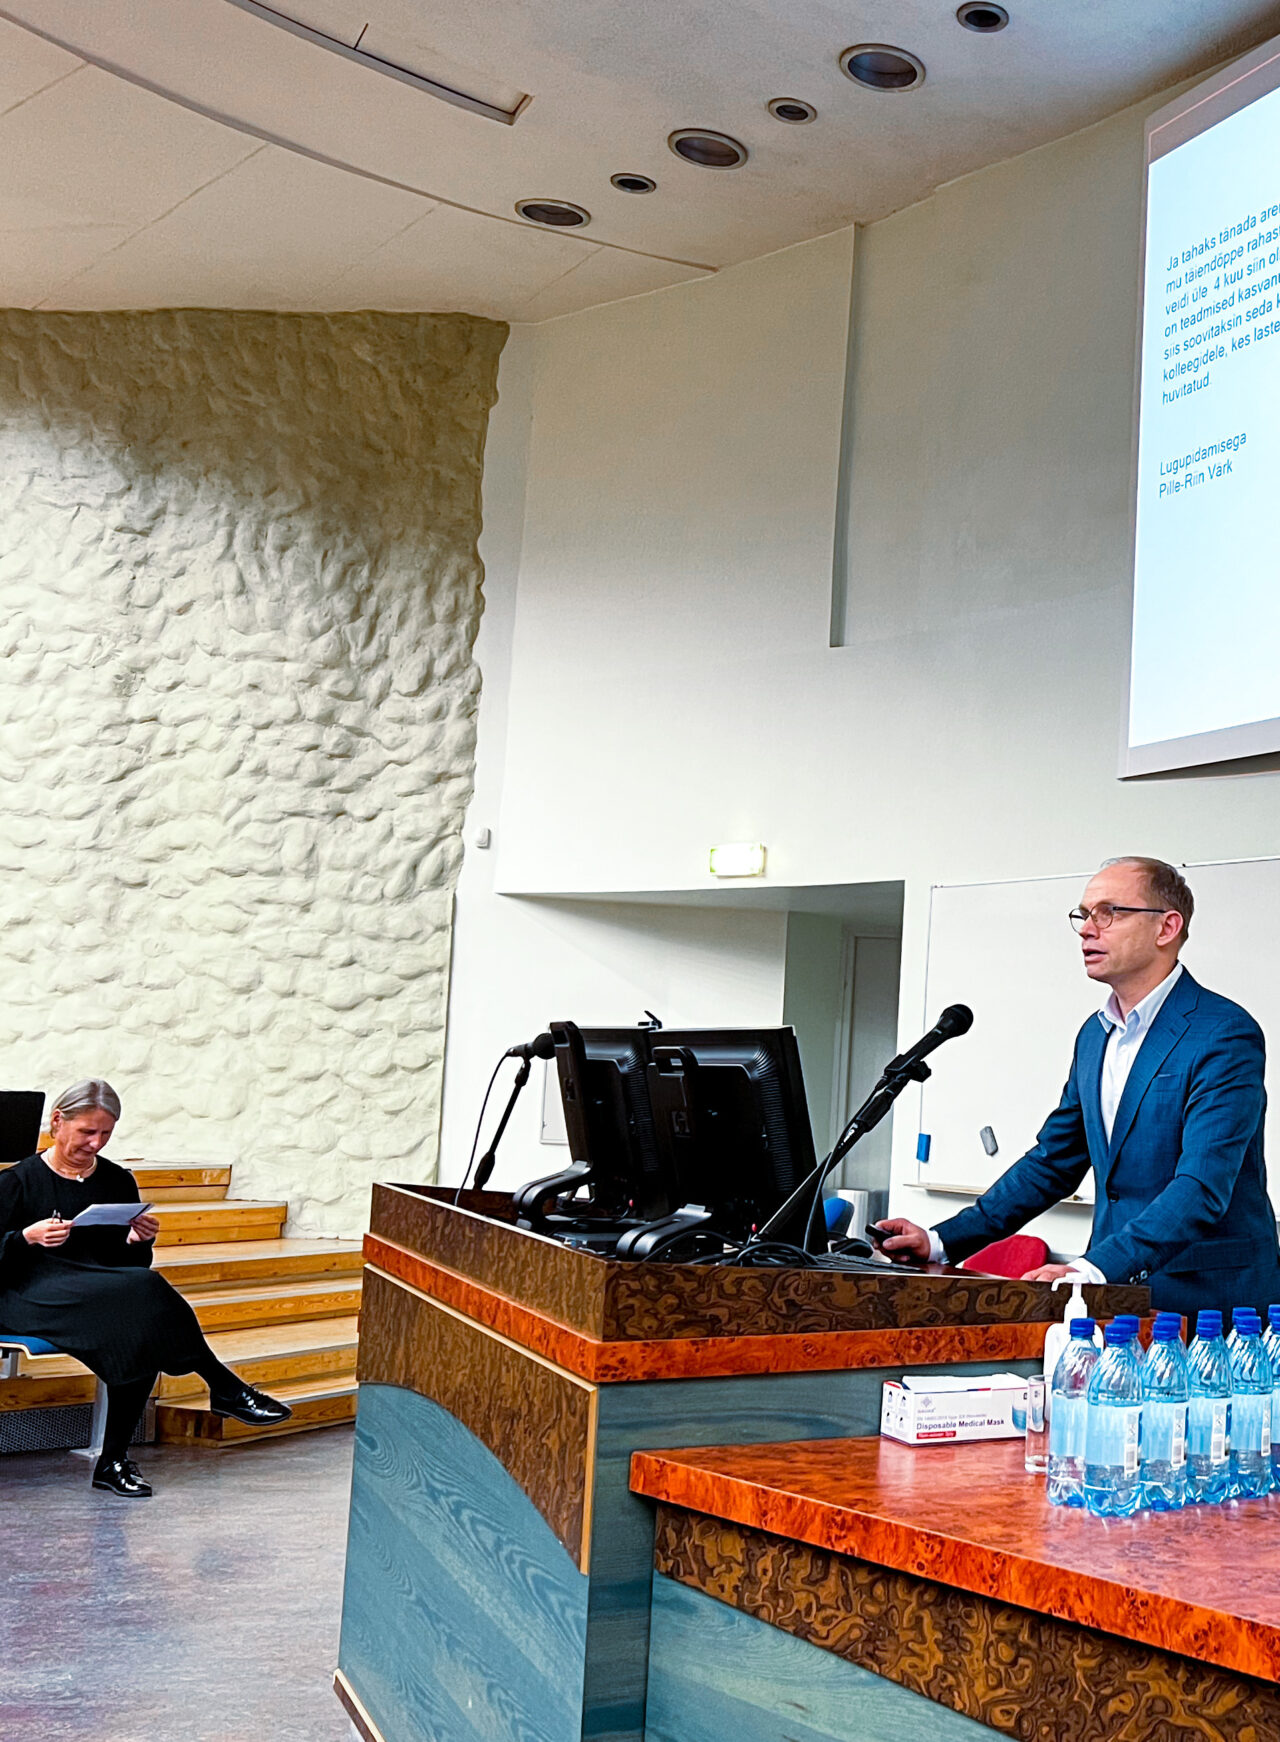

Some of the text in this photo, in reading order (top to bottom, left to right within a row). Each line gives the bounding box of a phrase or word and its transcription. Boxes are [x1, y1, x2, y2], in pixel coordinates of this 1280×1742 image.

[1166, 256, 1179, 271] Ja
[1182, 237, 1216, 264] tahaks
[1219, 214, 1256, 244] tänada
[1165, 292, 1189, 315] veidi
[1192, 285, 1208, 303] üle
[1214, 276, 1220, 291] 4
[1224, 268, 1243, 287] kuu
[1247, 257, 1265, 276] siin
[1166, 277, 1182, 294] mu
[1164, 323, 1177, 337] on
[1180, 291, 1235, 330] teadmised
[1164, 343, 1180, 360] siis
[1183, 314, 1242, 351] soovitaksin
[1245, 299, 1273, 322] seda
[1163, 345, 1228, 382] kolleegidele,
[1231, 334, 1251, 352] kes
[1160, 433, 1247, 476] Lugupidamisega
[1160, 470, 1205, 499] Pille-Riin
[916, 1418, 1004, 1430] Disposable Medical Mask
